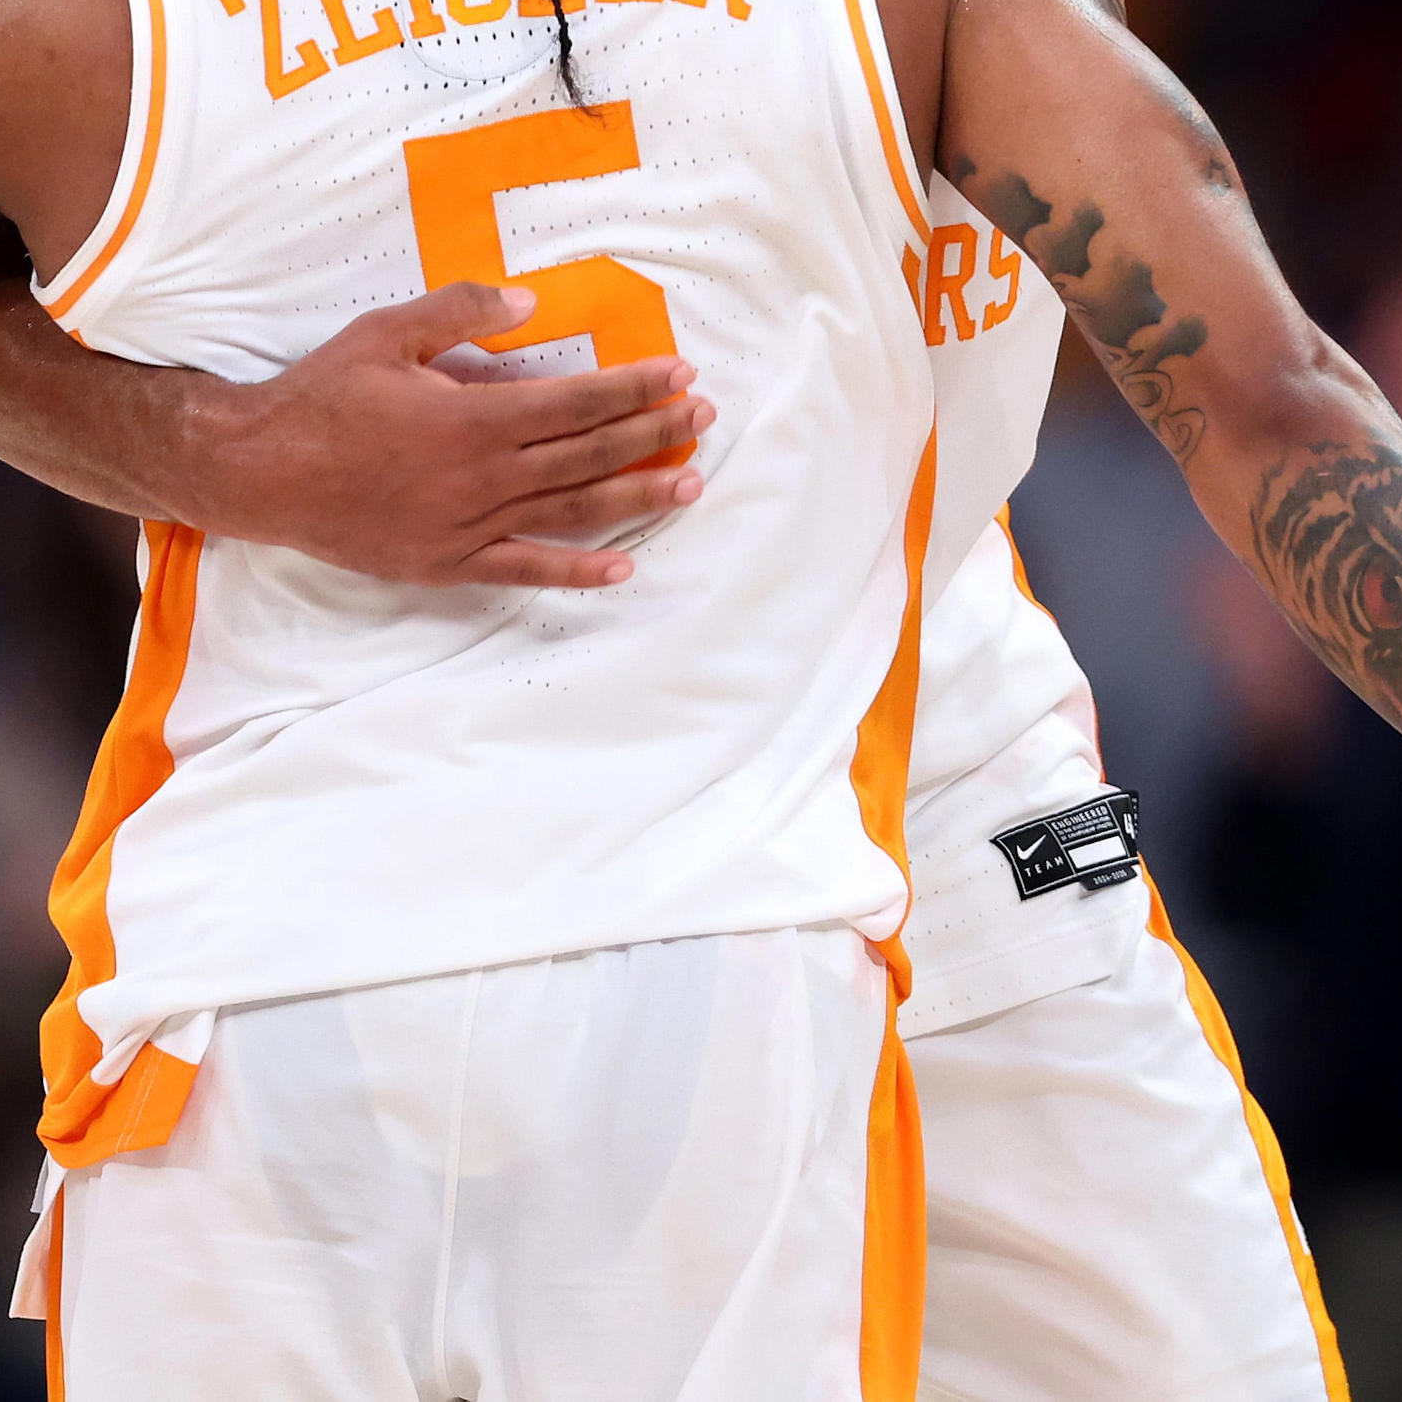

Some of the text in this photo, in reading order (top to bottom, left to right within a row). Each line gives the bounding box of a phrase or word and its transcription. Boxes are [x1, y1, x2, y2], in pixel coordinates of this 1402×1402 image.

[402, 99, 698, 474] 5
[1051, 805, 1108, 831] ENGINEERED
[1024, 856, 1064, 878] TEAM
